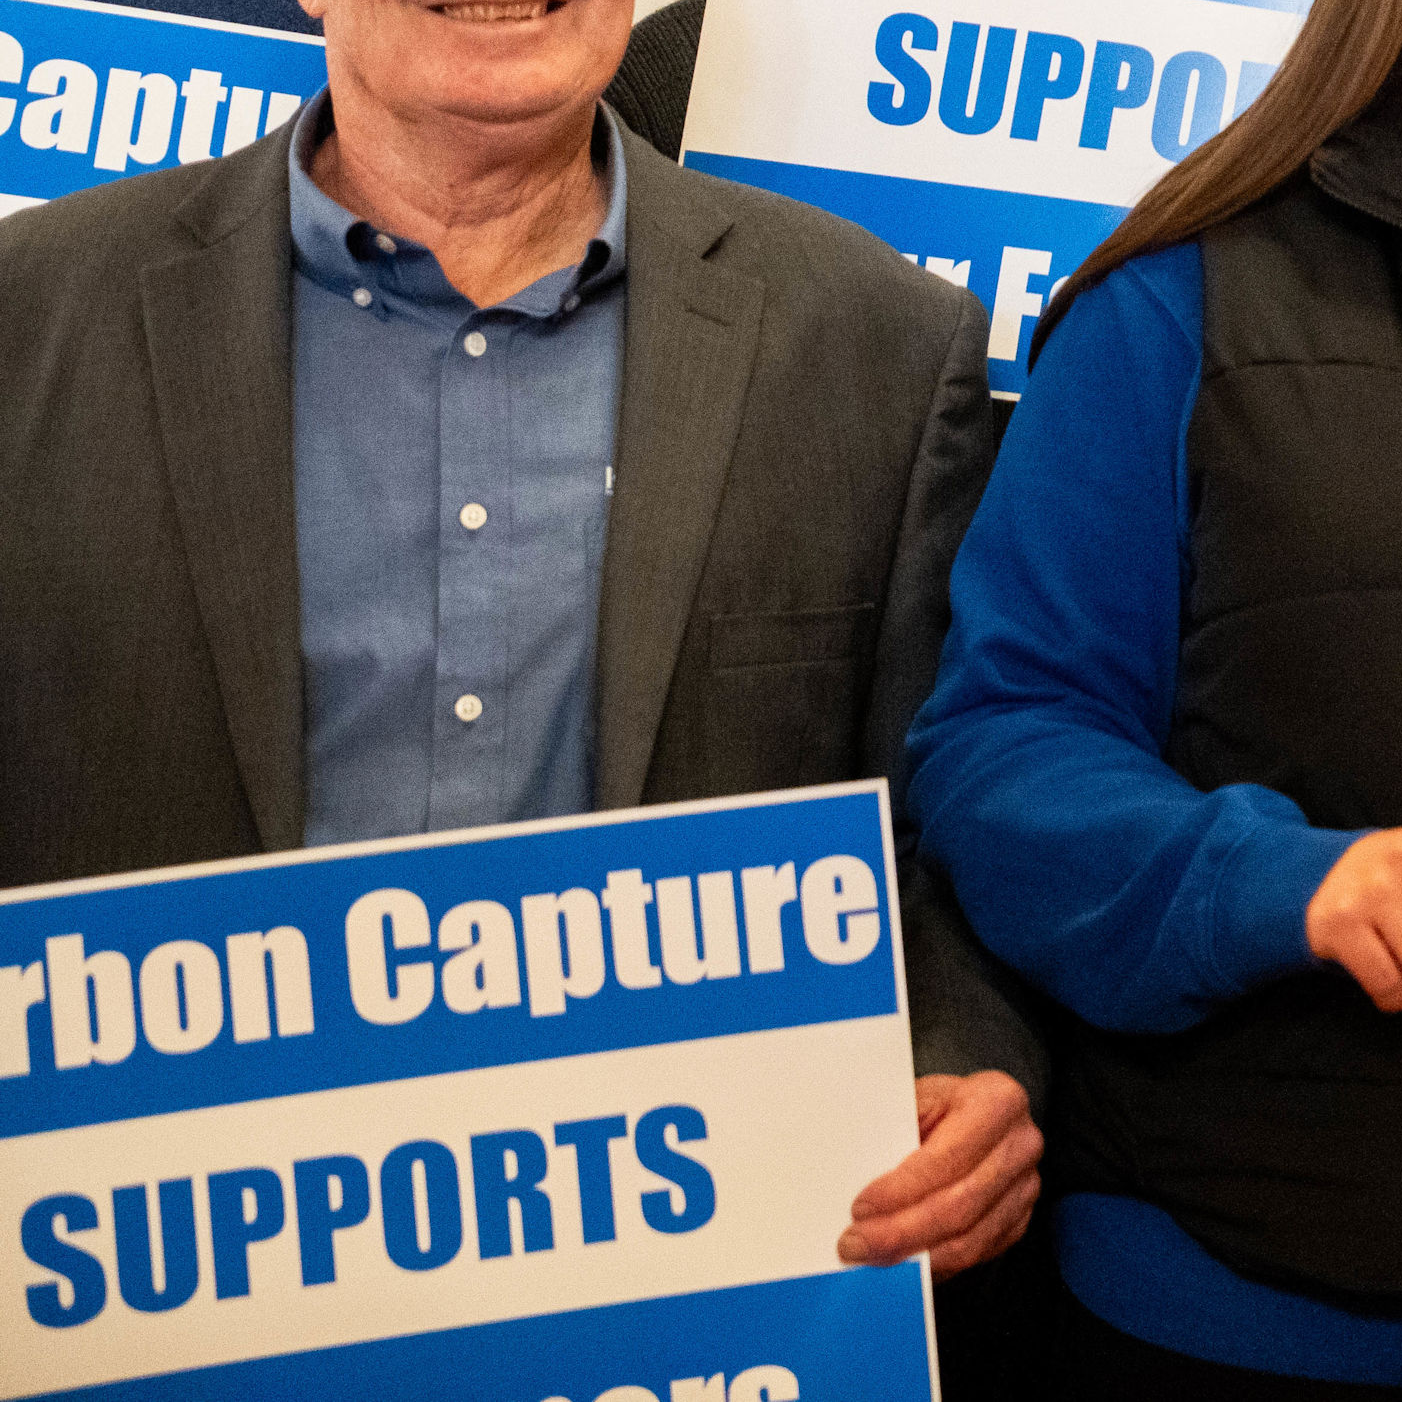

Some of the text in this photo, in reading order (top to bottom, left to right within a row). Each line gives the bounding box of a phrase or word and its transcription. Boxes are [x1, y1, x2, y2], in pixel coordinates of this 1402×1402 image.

[867, 11, 1279, 164] SUPPO
[344, 853, 883, 1026] Capture
[20, 1104, 717, 1330] SUPPORTS
